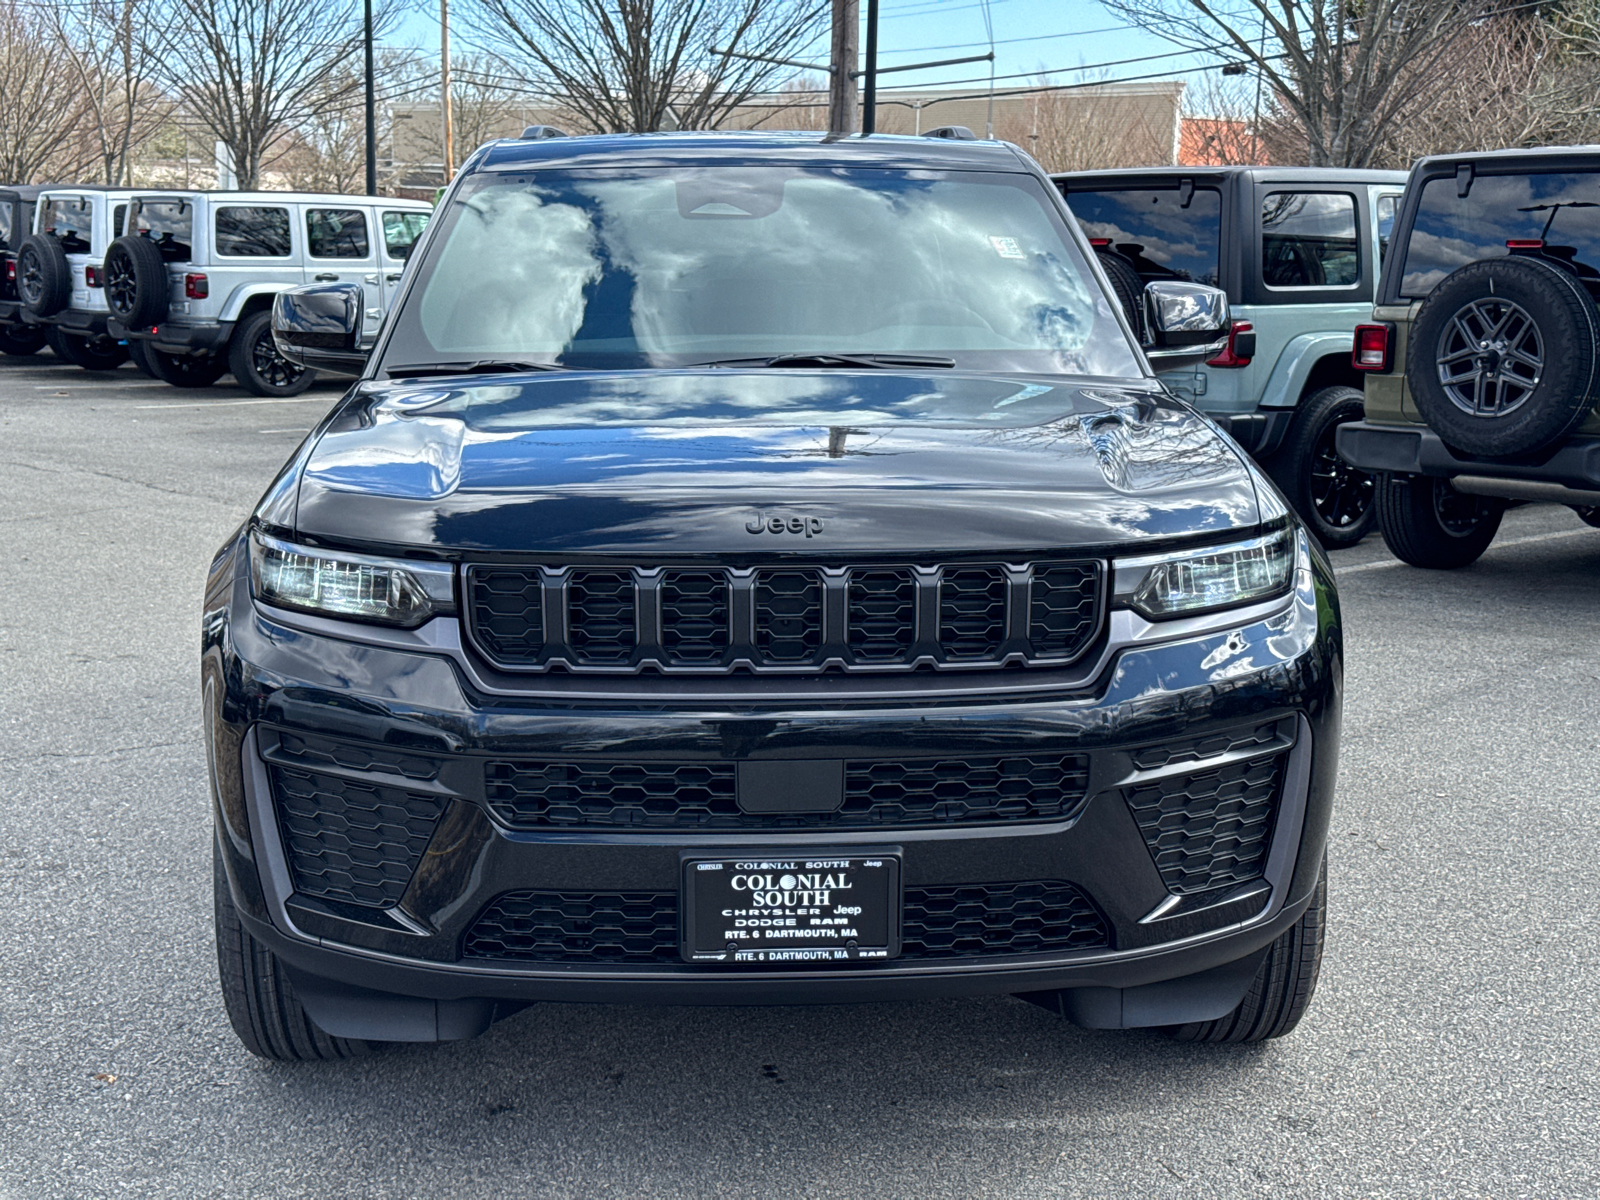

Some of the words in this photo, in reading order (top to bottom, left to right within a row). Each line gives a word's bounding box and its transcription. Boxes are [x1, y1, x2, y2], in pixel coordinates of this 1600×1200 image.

[745, 511, 825, 539] Jeep
[734, 861, 798, 871] COLONIAL
[804, 860, 850, 870] SOUTH
[862, 859, 883, 868] Jeep
[730, 873, 852, 891] COLONIAL
[752, 889, 831, 907] SOUTH
[721, 908, 821, 917] CHRYSLER
[832, 904, 862, 916] Jeep
[734, 918, 797, 927] DODGE
[809, 917, 849, 926] RAM
[724, 930, 750, 940] RTE.
[752, 930, 760, 939] 6
[765, 928, 839, 939] DARTMOUTH,
[841, 928, 859, 938] MA
[734, 952, 757, 961] RTE.
[758, 952, 765, 961] 6
[769, 950, 833, 961] DARTMOUTH,
[834, 950, 849, 960] MA
[859, 950, 888, 958] RAM
